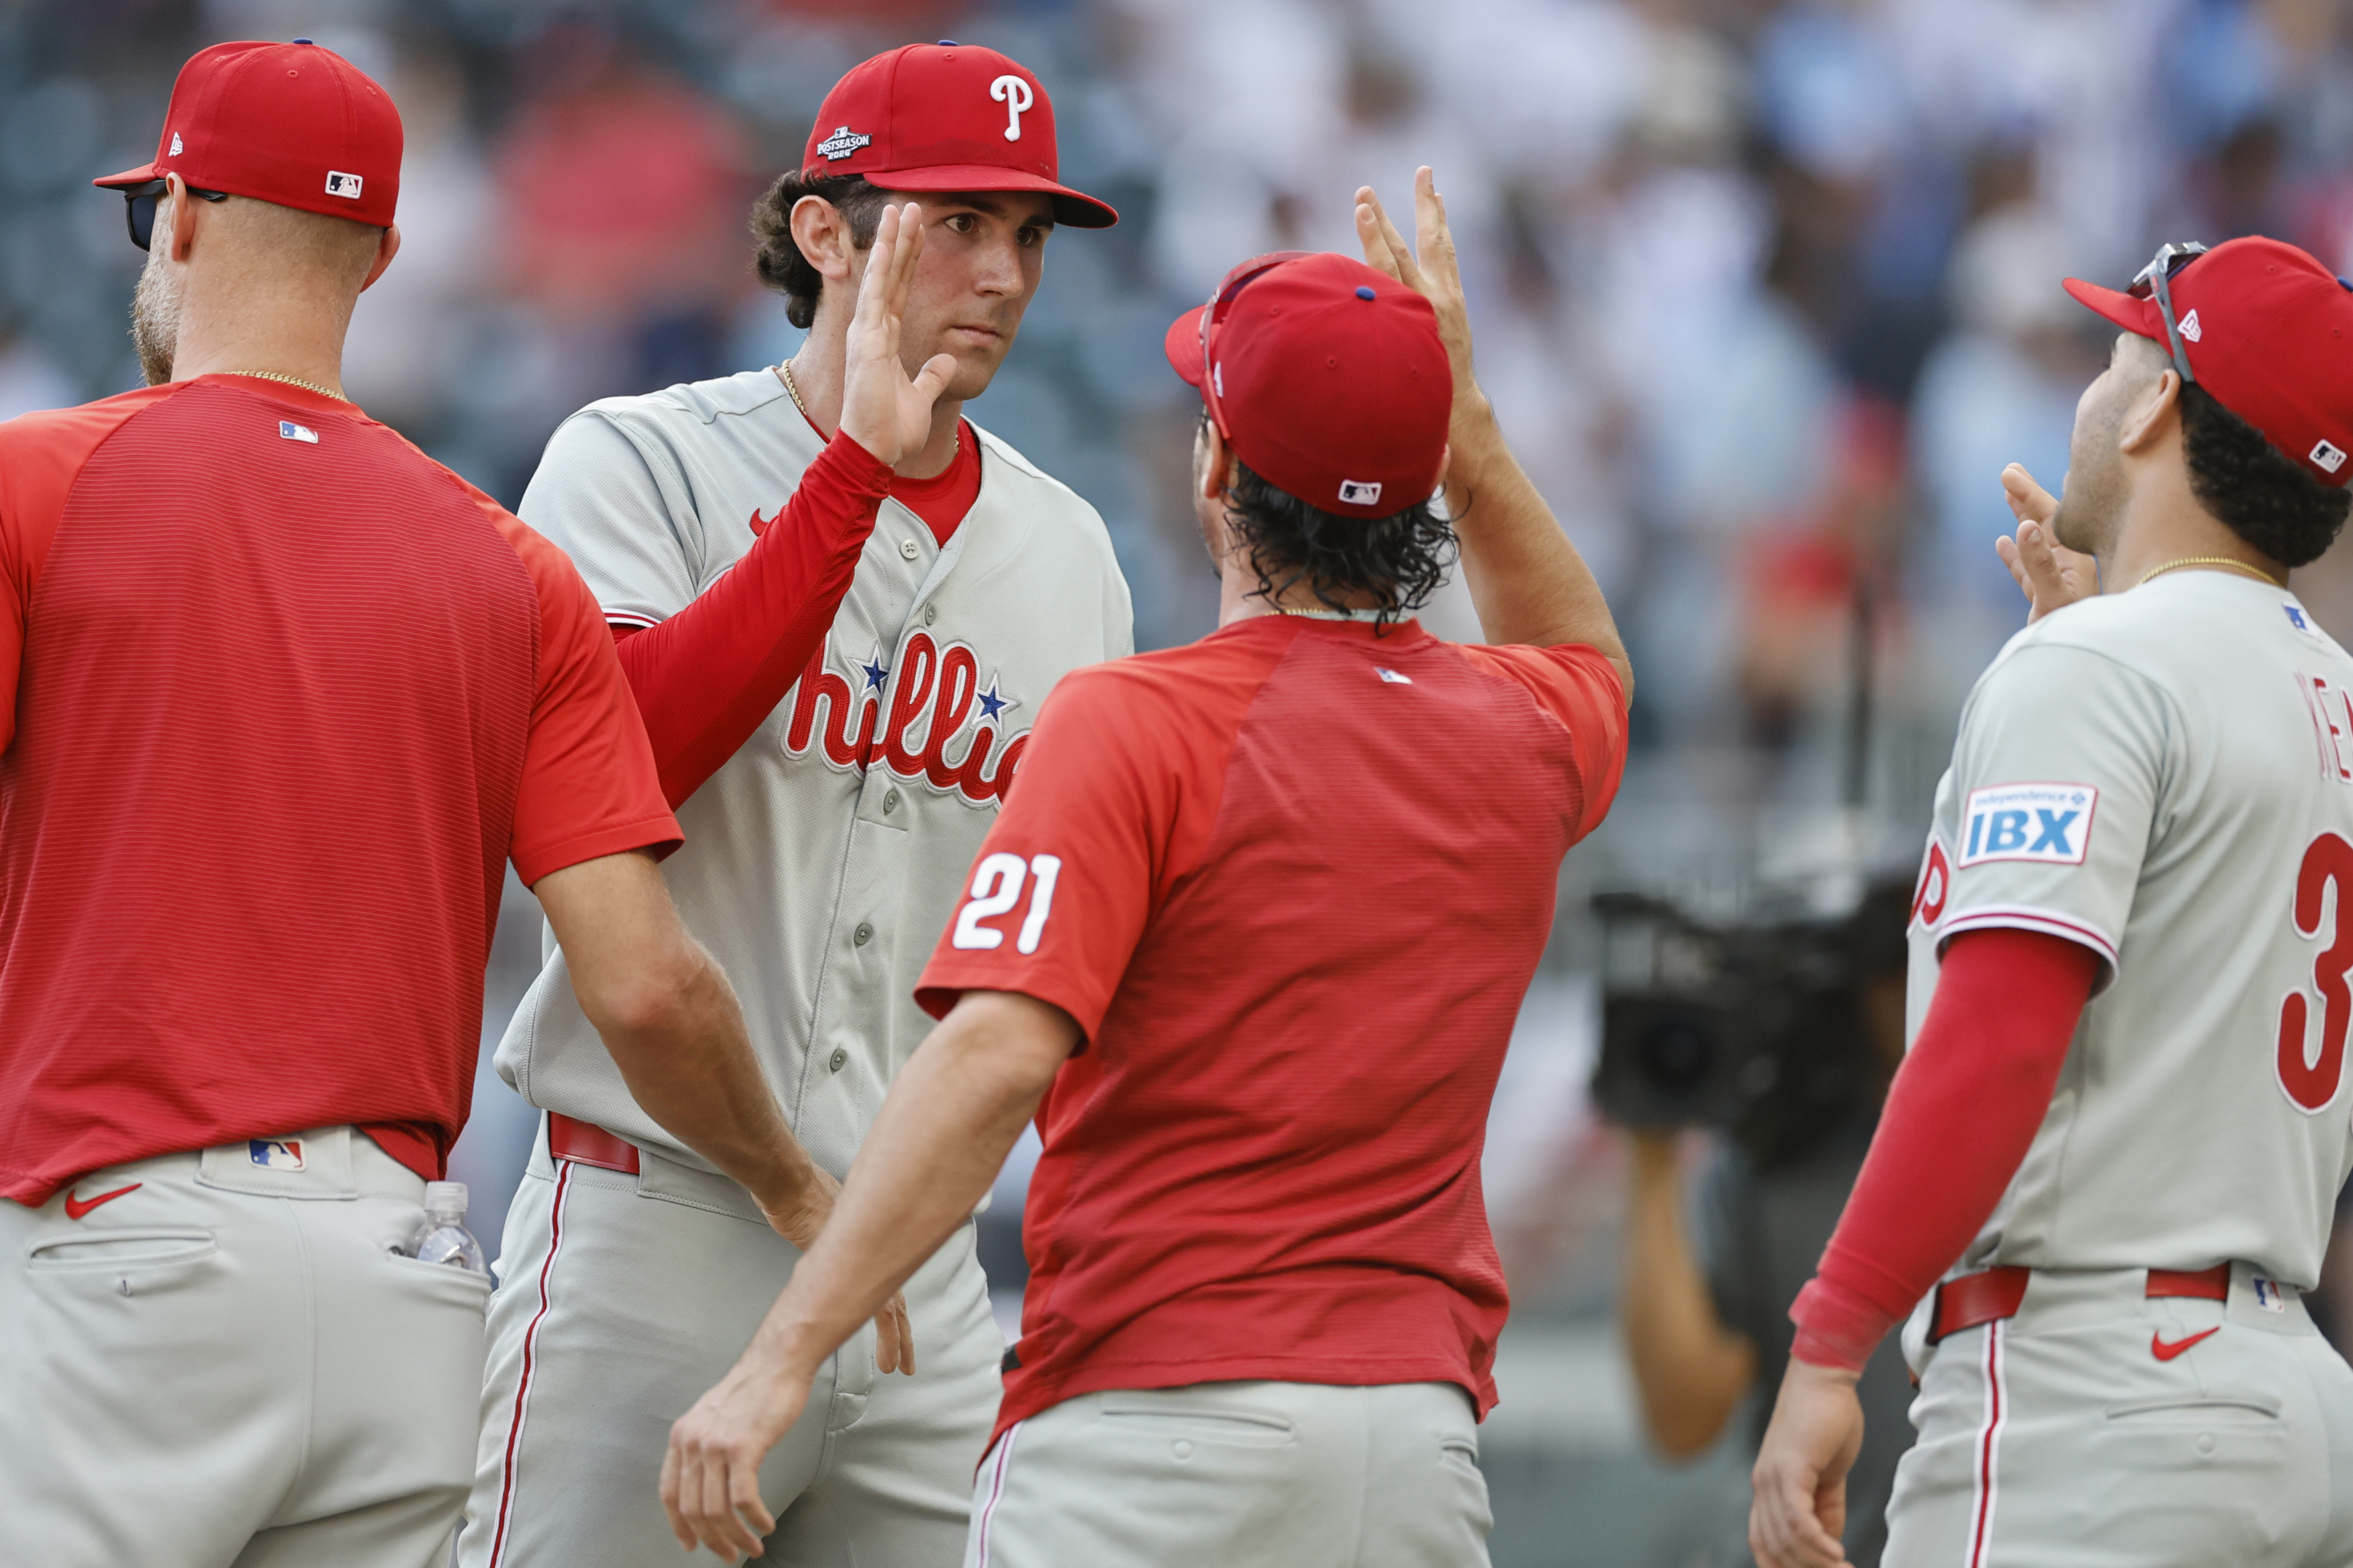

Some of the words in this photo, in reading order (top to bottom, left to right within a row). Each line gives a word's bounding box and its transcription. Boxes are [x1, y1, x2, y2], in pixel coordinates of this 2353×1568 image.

[990, 75, 1034, 142] P
[817, 135, 869, 155] POSTSEASON
[1967, 808, 2080, 858] IBX
[952, 852, 1062, 955] 21
